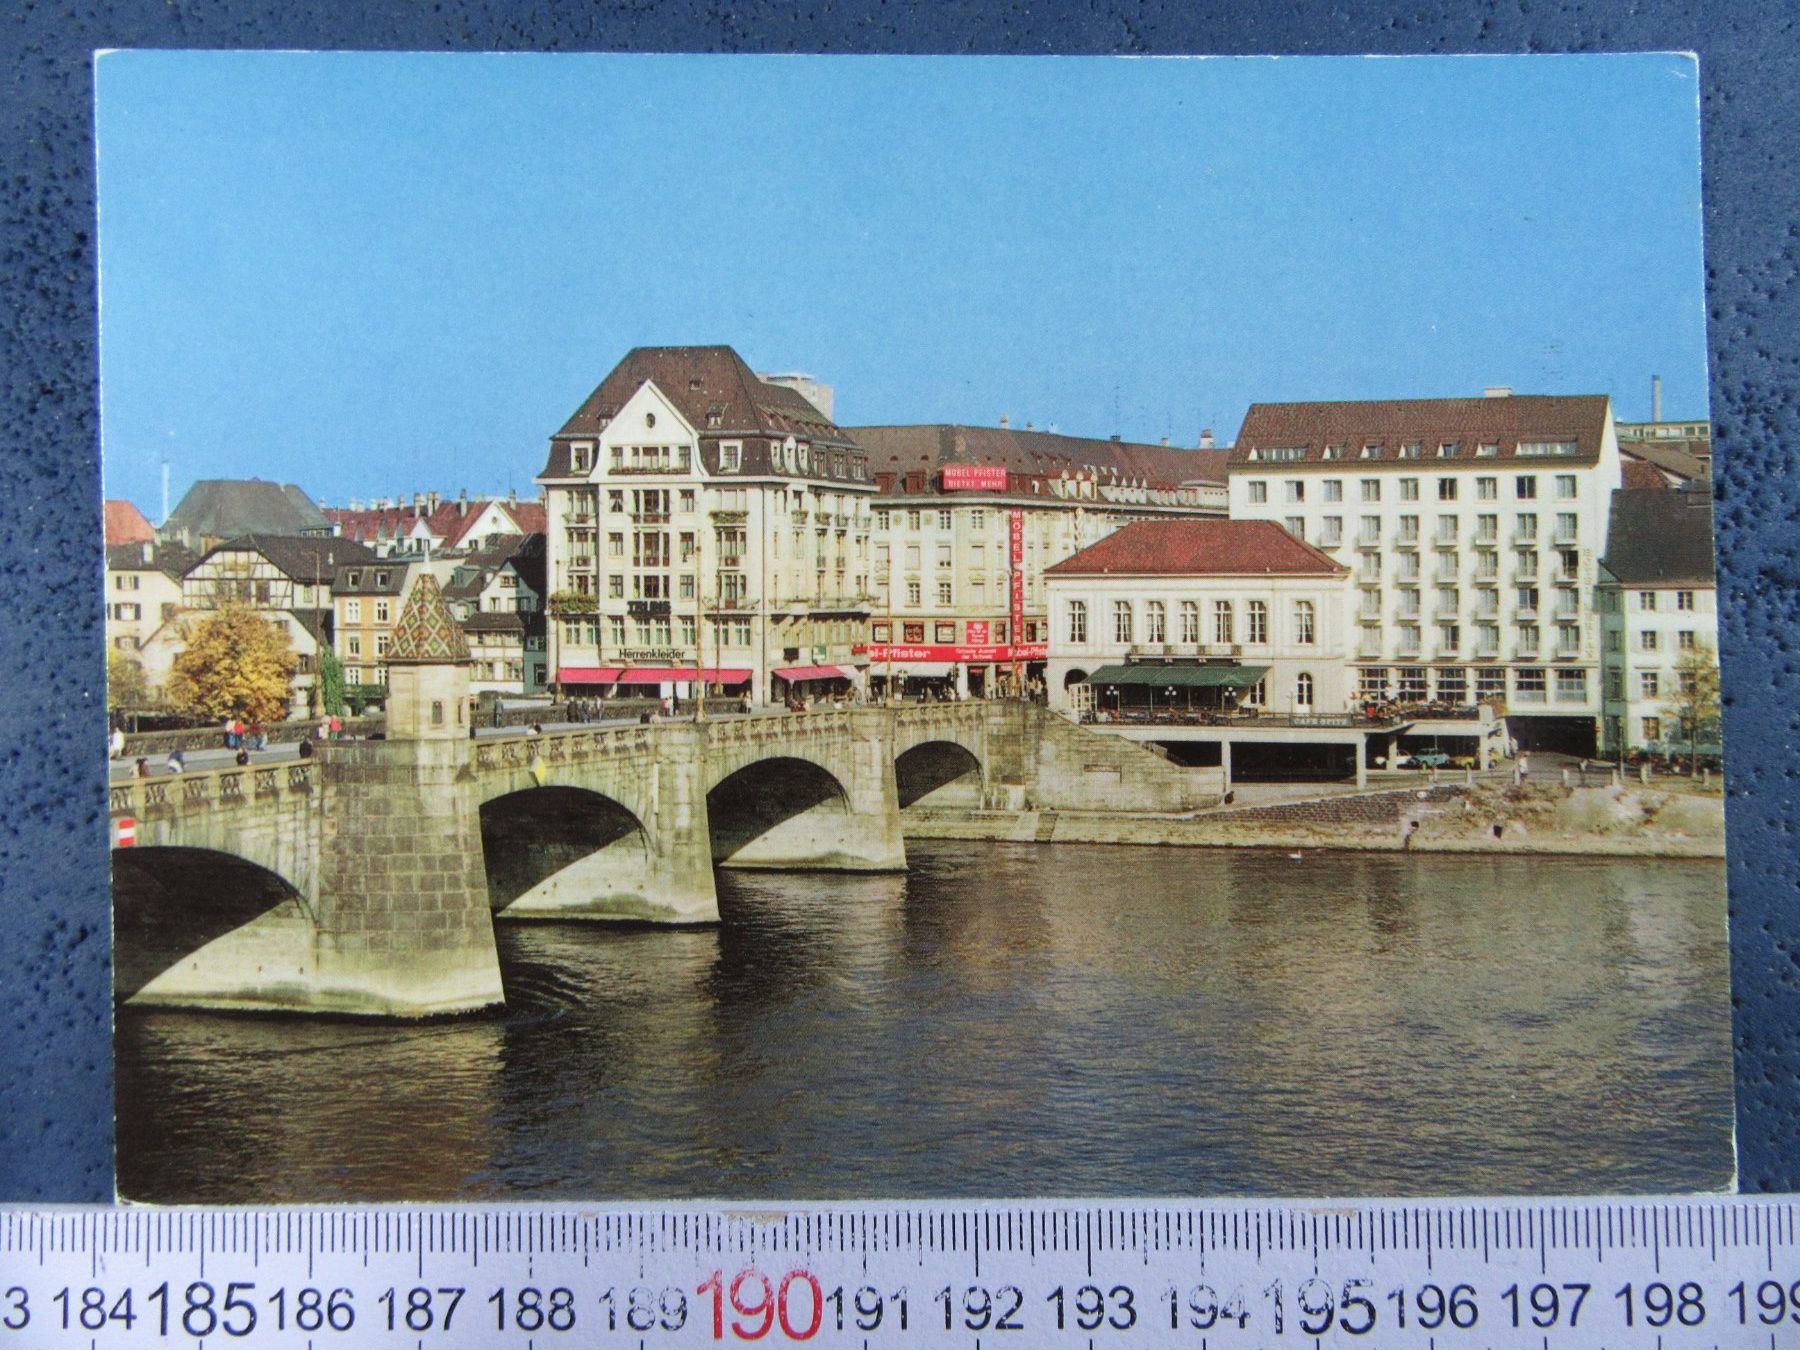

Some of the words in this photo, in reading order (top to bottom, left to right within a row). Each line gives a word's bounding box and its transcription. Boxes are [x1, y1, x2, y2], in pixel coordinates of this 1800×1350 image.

[619, 649, 685, 659] Herrenkleider
[53, 1286, 137, 1330] 184
[148, 1281, 257, 1337] 185
[268, 1287, 355, 1331] 186
[379, 1287, 465, 1331] 187
[489, 1287, 576, 1331] 188
[598, 1286, 688, 1331] 189
[696, 1269, 823, 1340] 190
[826, 1286, 908, 1331] 191
[934, 1285, 1024, 1331] 192
[1046, 1285, 1138, 1330] 193
[1160, 1282, 1251, 1330] 194
[1263, 1278, 1377, 1335] 195
[1387, 1284, 1479, 1329] 196
[1501, 1283, 1592, 1328] 197
[1615, 1282, 1706, 1327] 198
